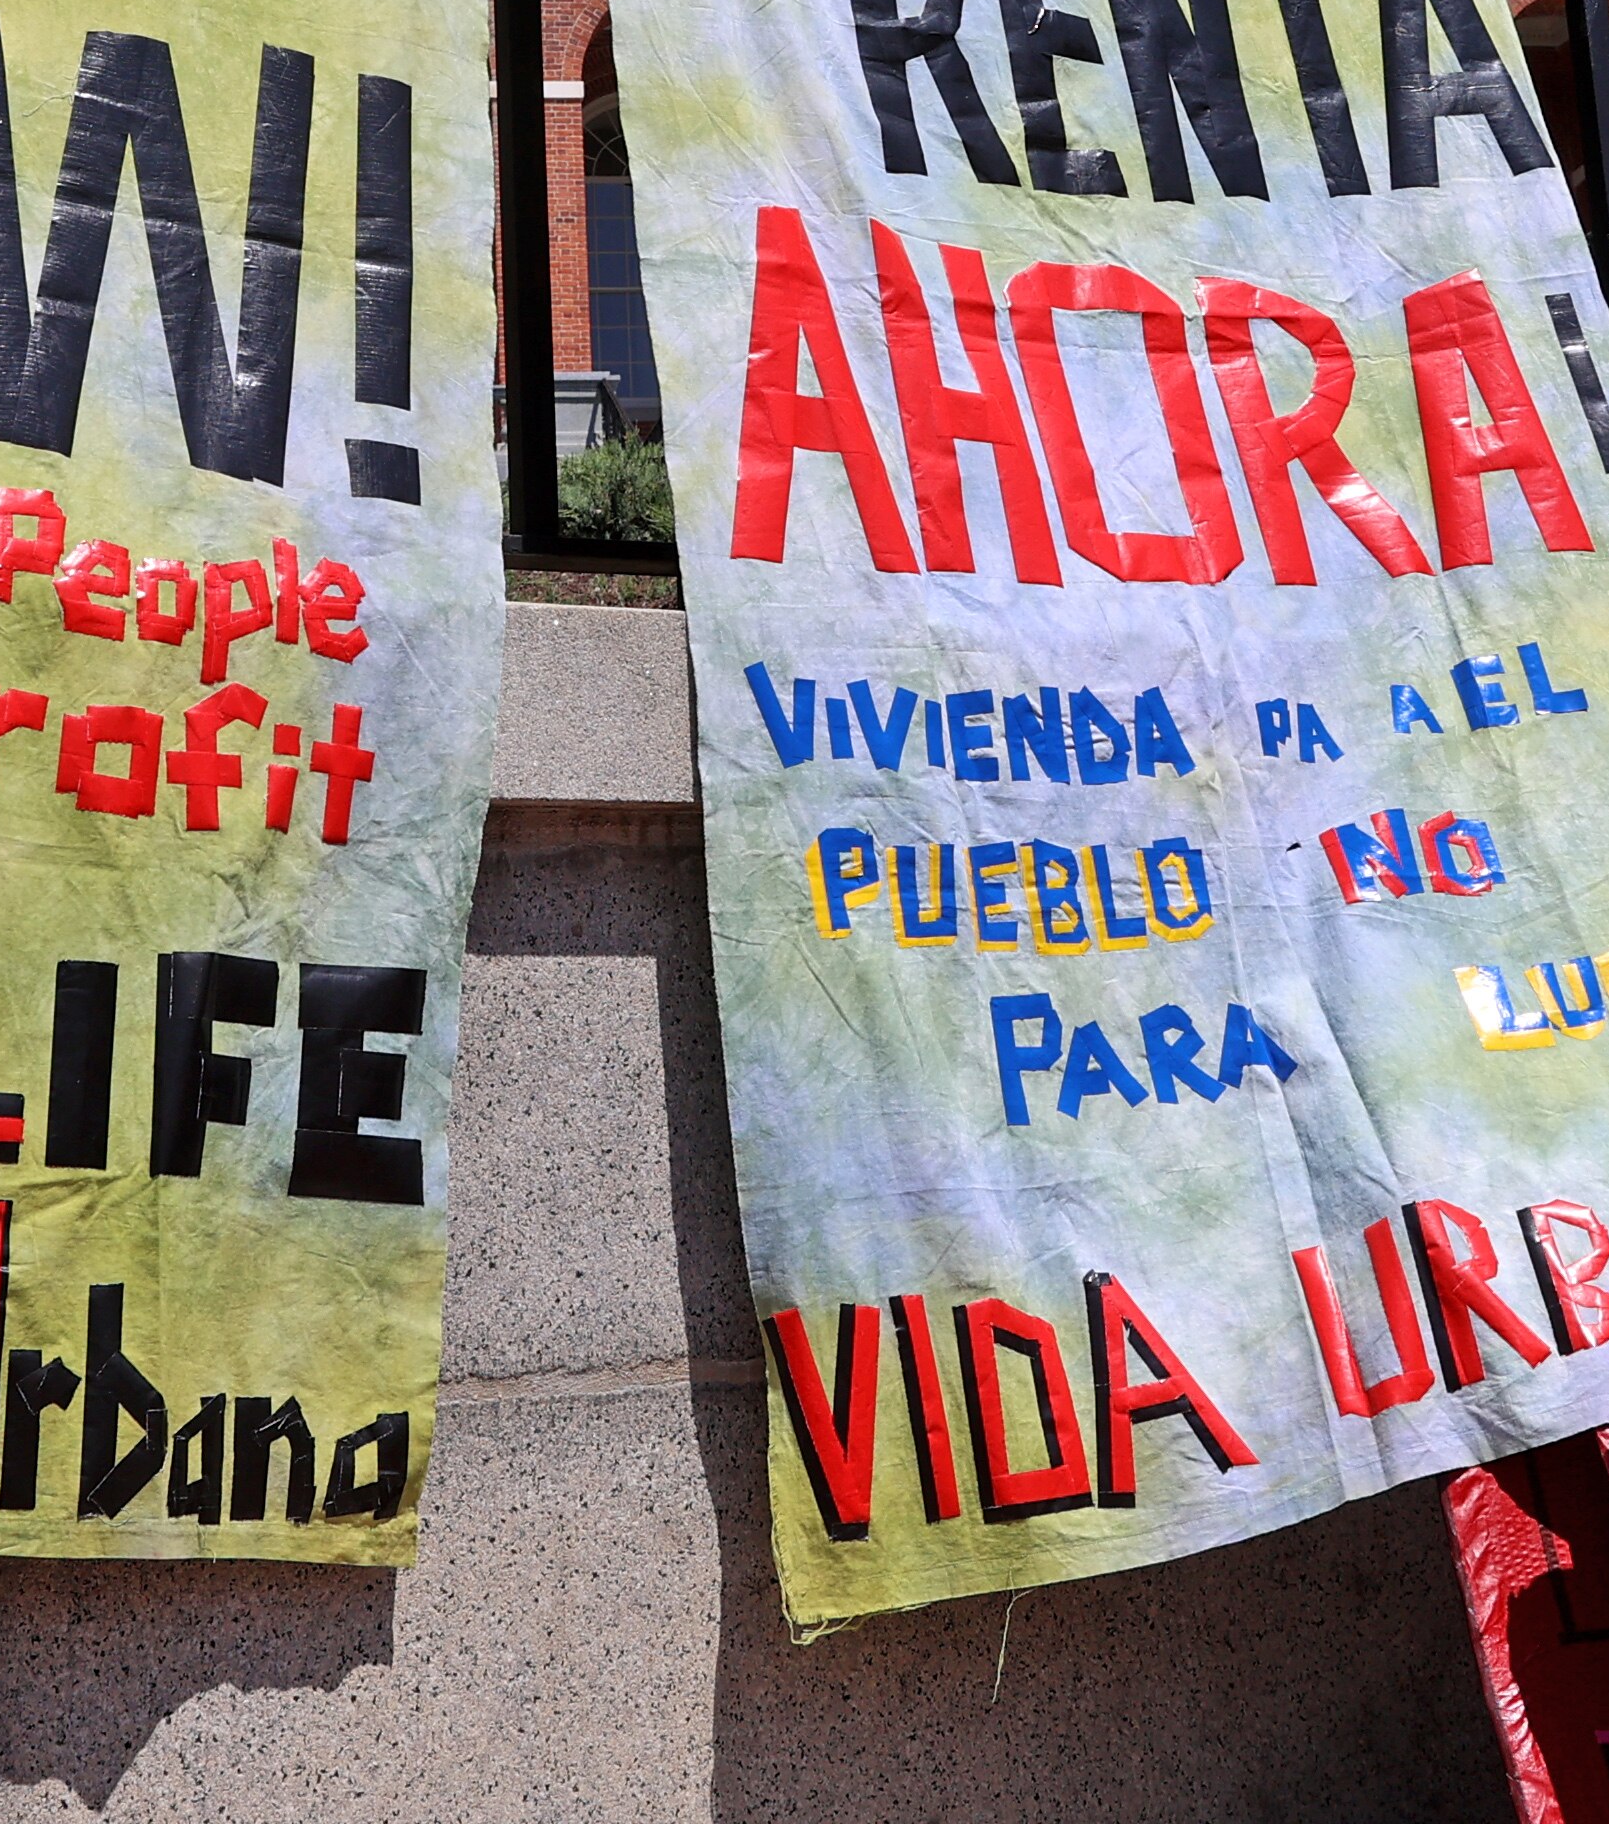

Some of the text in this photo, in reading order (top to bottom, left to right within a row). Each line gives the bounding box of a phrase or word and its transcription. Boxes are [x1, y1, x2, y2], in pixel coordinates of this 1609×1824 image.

[744, 662, 1195, 786] VIVIENDA
[805, 808, 1507, 958] PUEBLO NO
[992, 991, 1298, 1126] PARA
[764, 1269, 1258, 1543] VIDA
